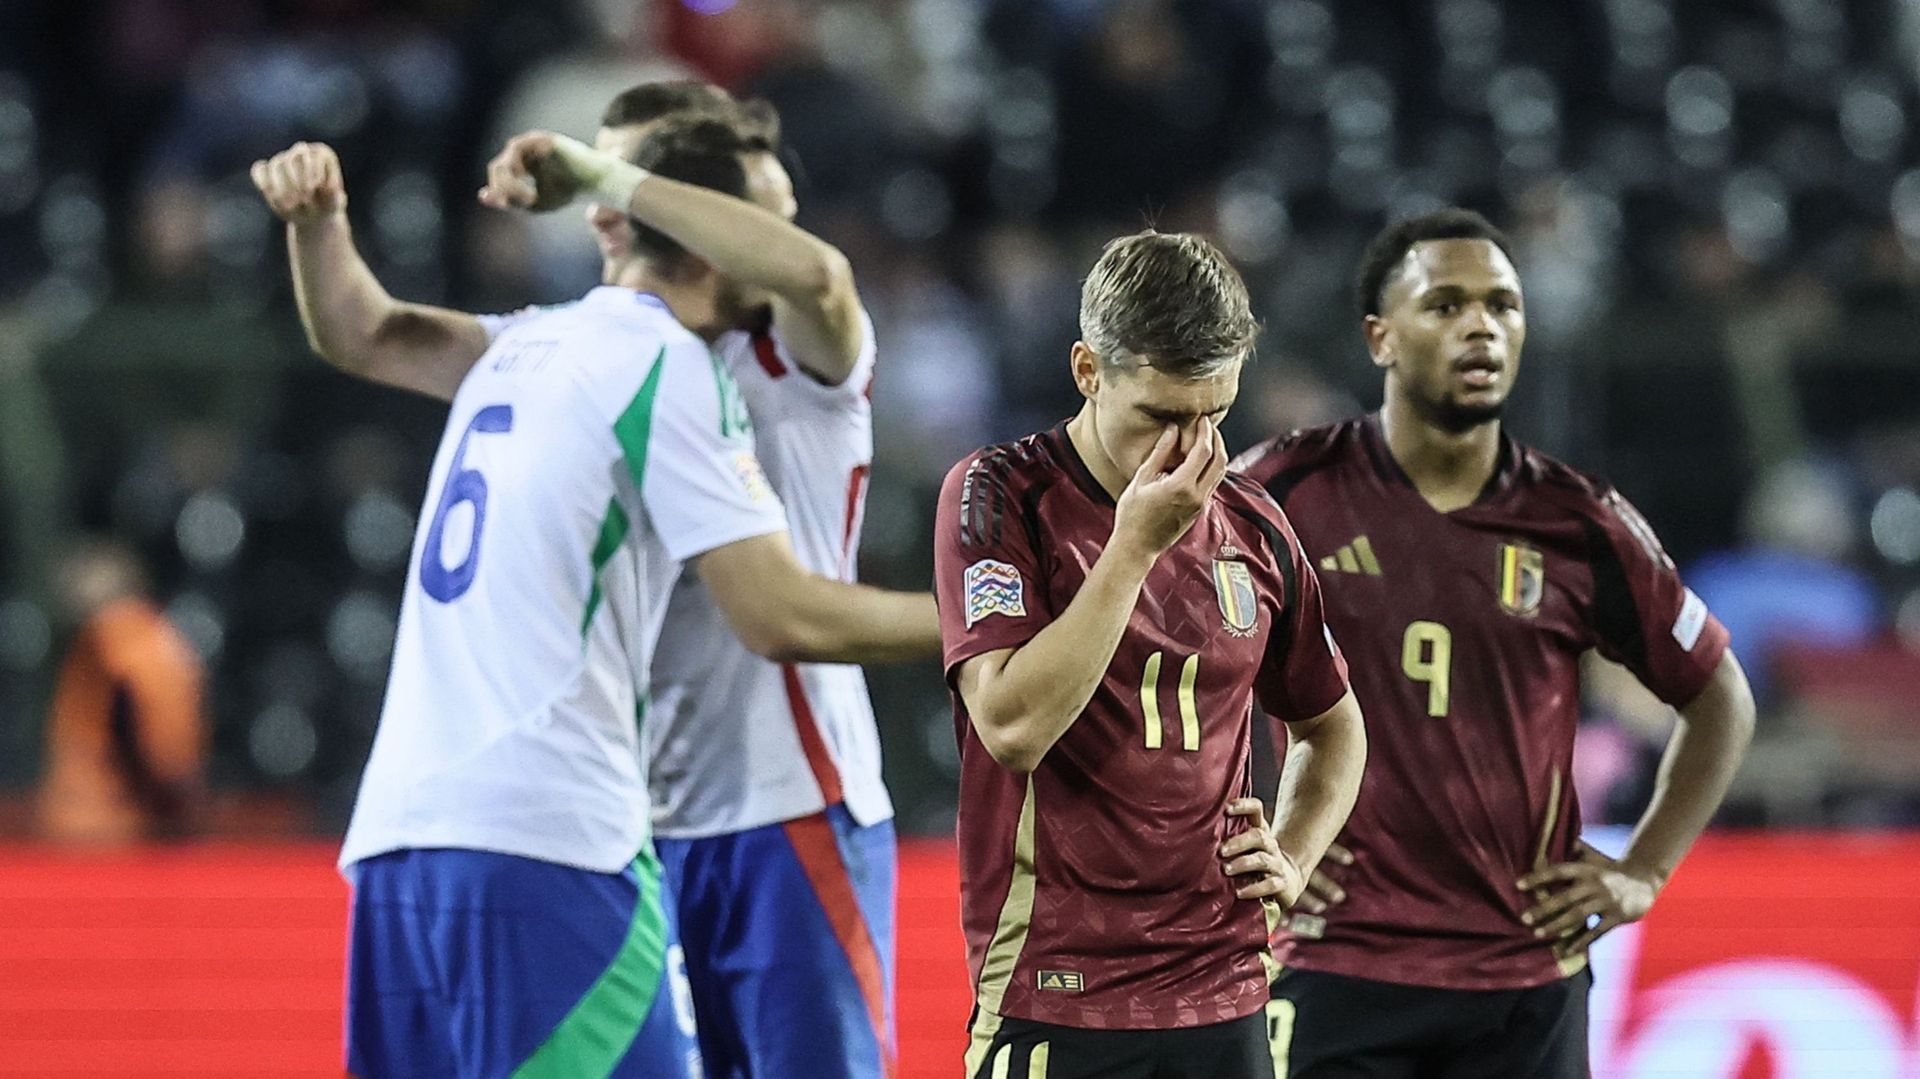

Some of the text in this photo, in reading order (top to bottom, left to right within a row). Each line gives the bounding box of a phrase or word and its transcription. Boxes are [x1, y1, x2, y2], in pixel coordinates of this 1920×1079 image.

[420, 404, 513, 604] 6
[1140, 651, 1200, 751] 11
[1402, 619, 1452, 718] 9
